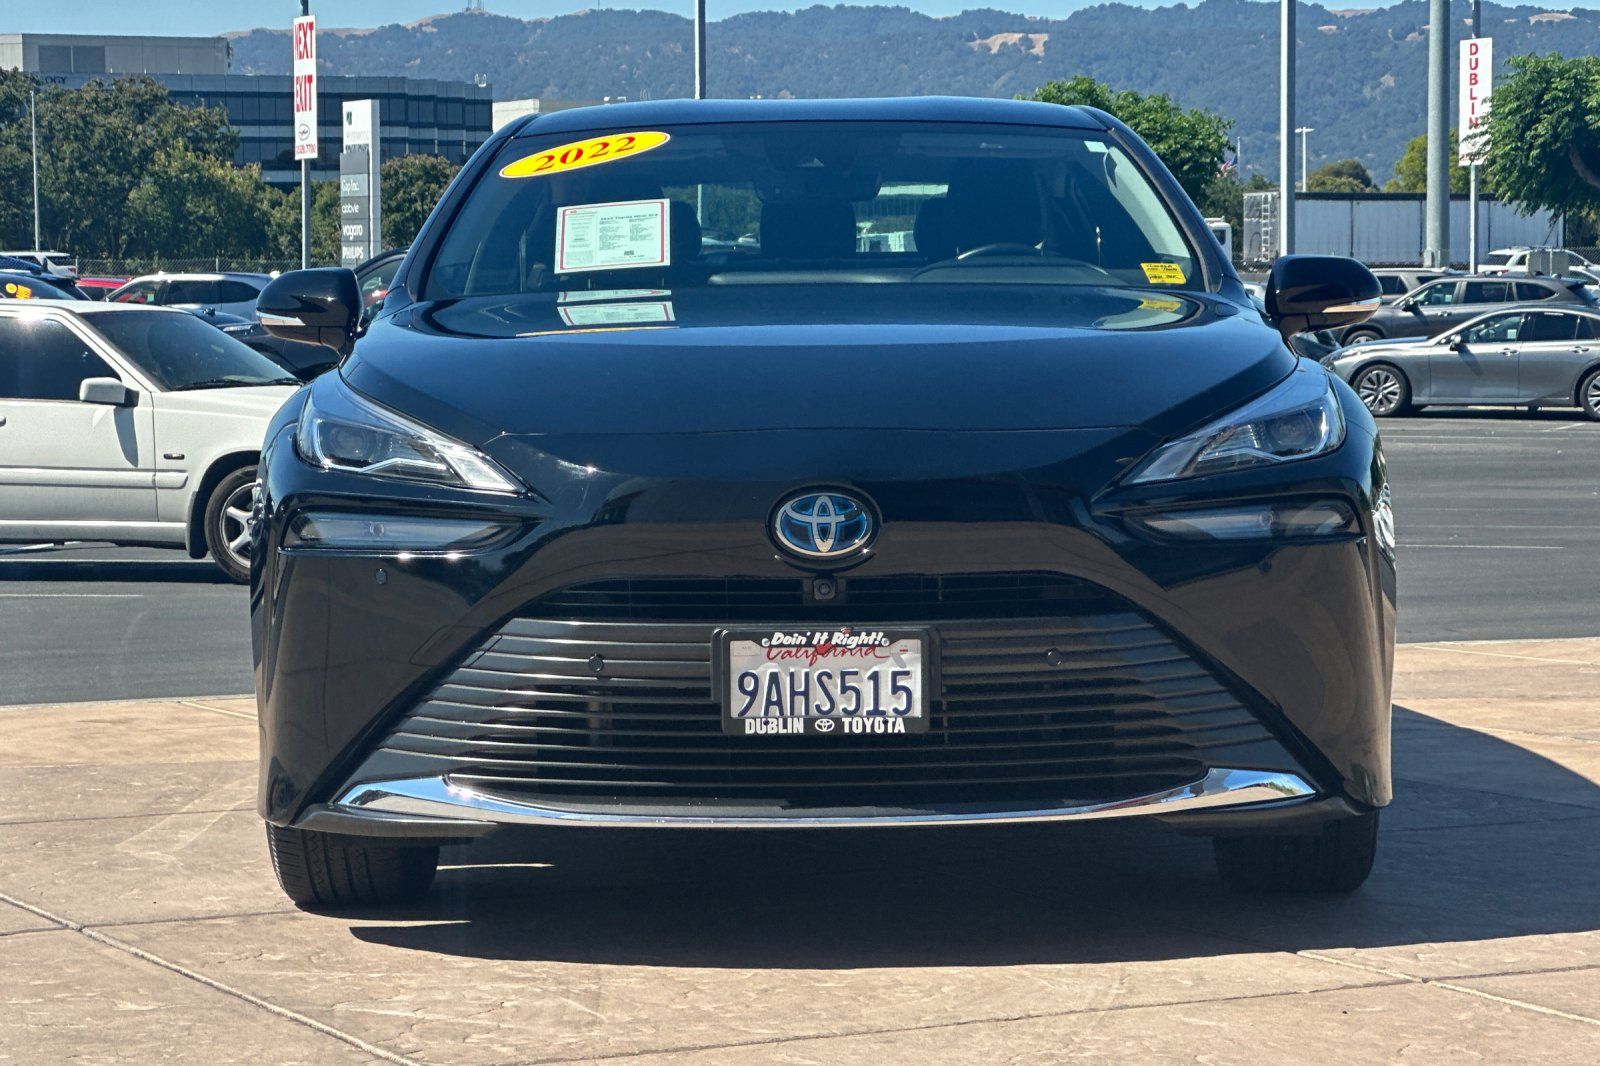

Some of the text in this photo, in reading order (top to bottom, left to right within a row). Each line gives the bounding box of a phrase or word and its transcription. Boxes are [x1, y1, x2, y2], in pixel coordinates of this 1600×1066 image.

[295, 21, 314, 60] NEXT
[295, 74, 313, 112] EXIT
[1469, 42, 1479, 129] DUBLIN
[532, 136, 636, 172] 2022
[342, 224, 363, 241] vagaro
[341, 246, 364, 260] PHILIPS
[770, 631, 812, 646] Doin'
[812, 631, 830, 646] It
[831, 631, 884, 648] Right!
[766, 646, 890, 667] California
[737, 670, 913, 717] 9AHS515
[745, 717, 906, 735] DUBLIN TOYOTA
